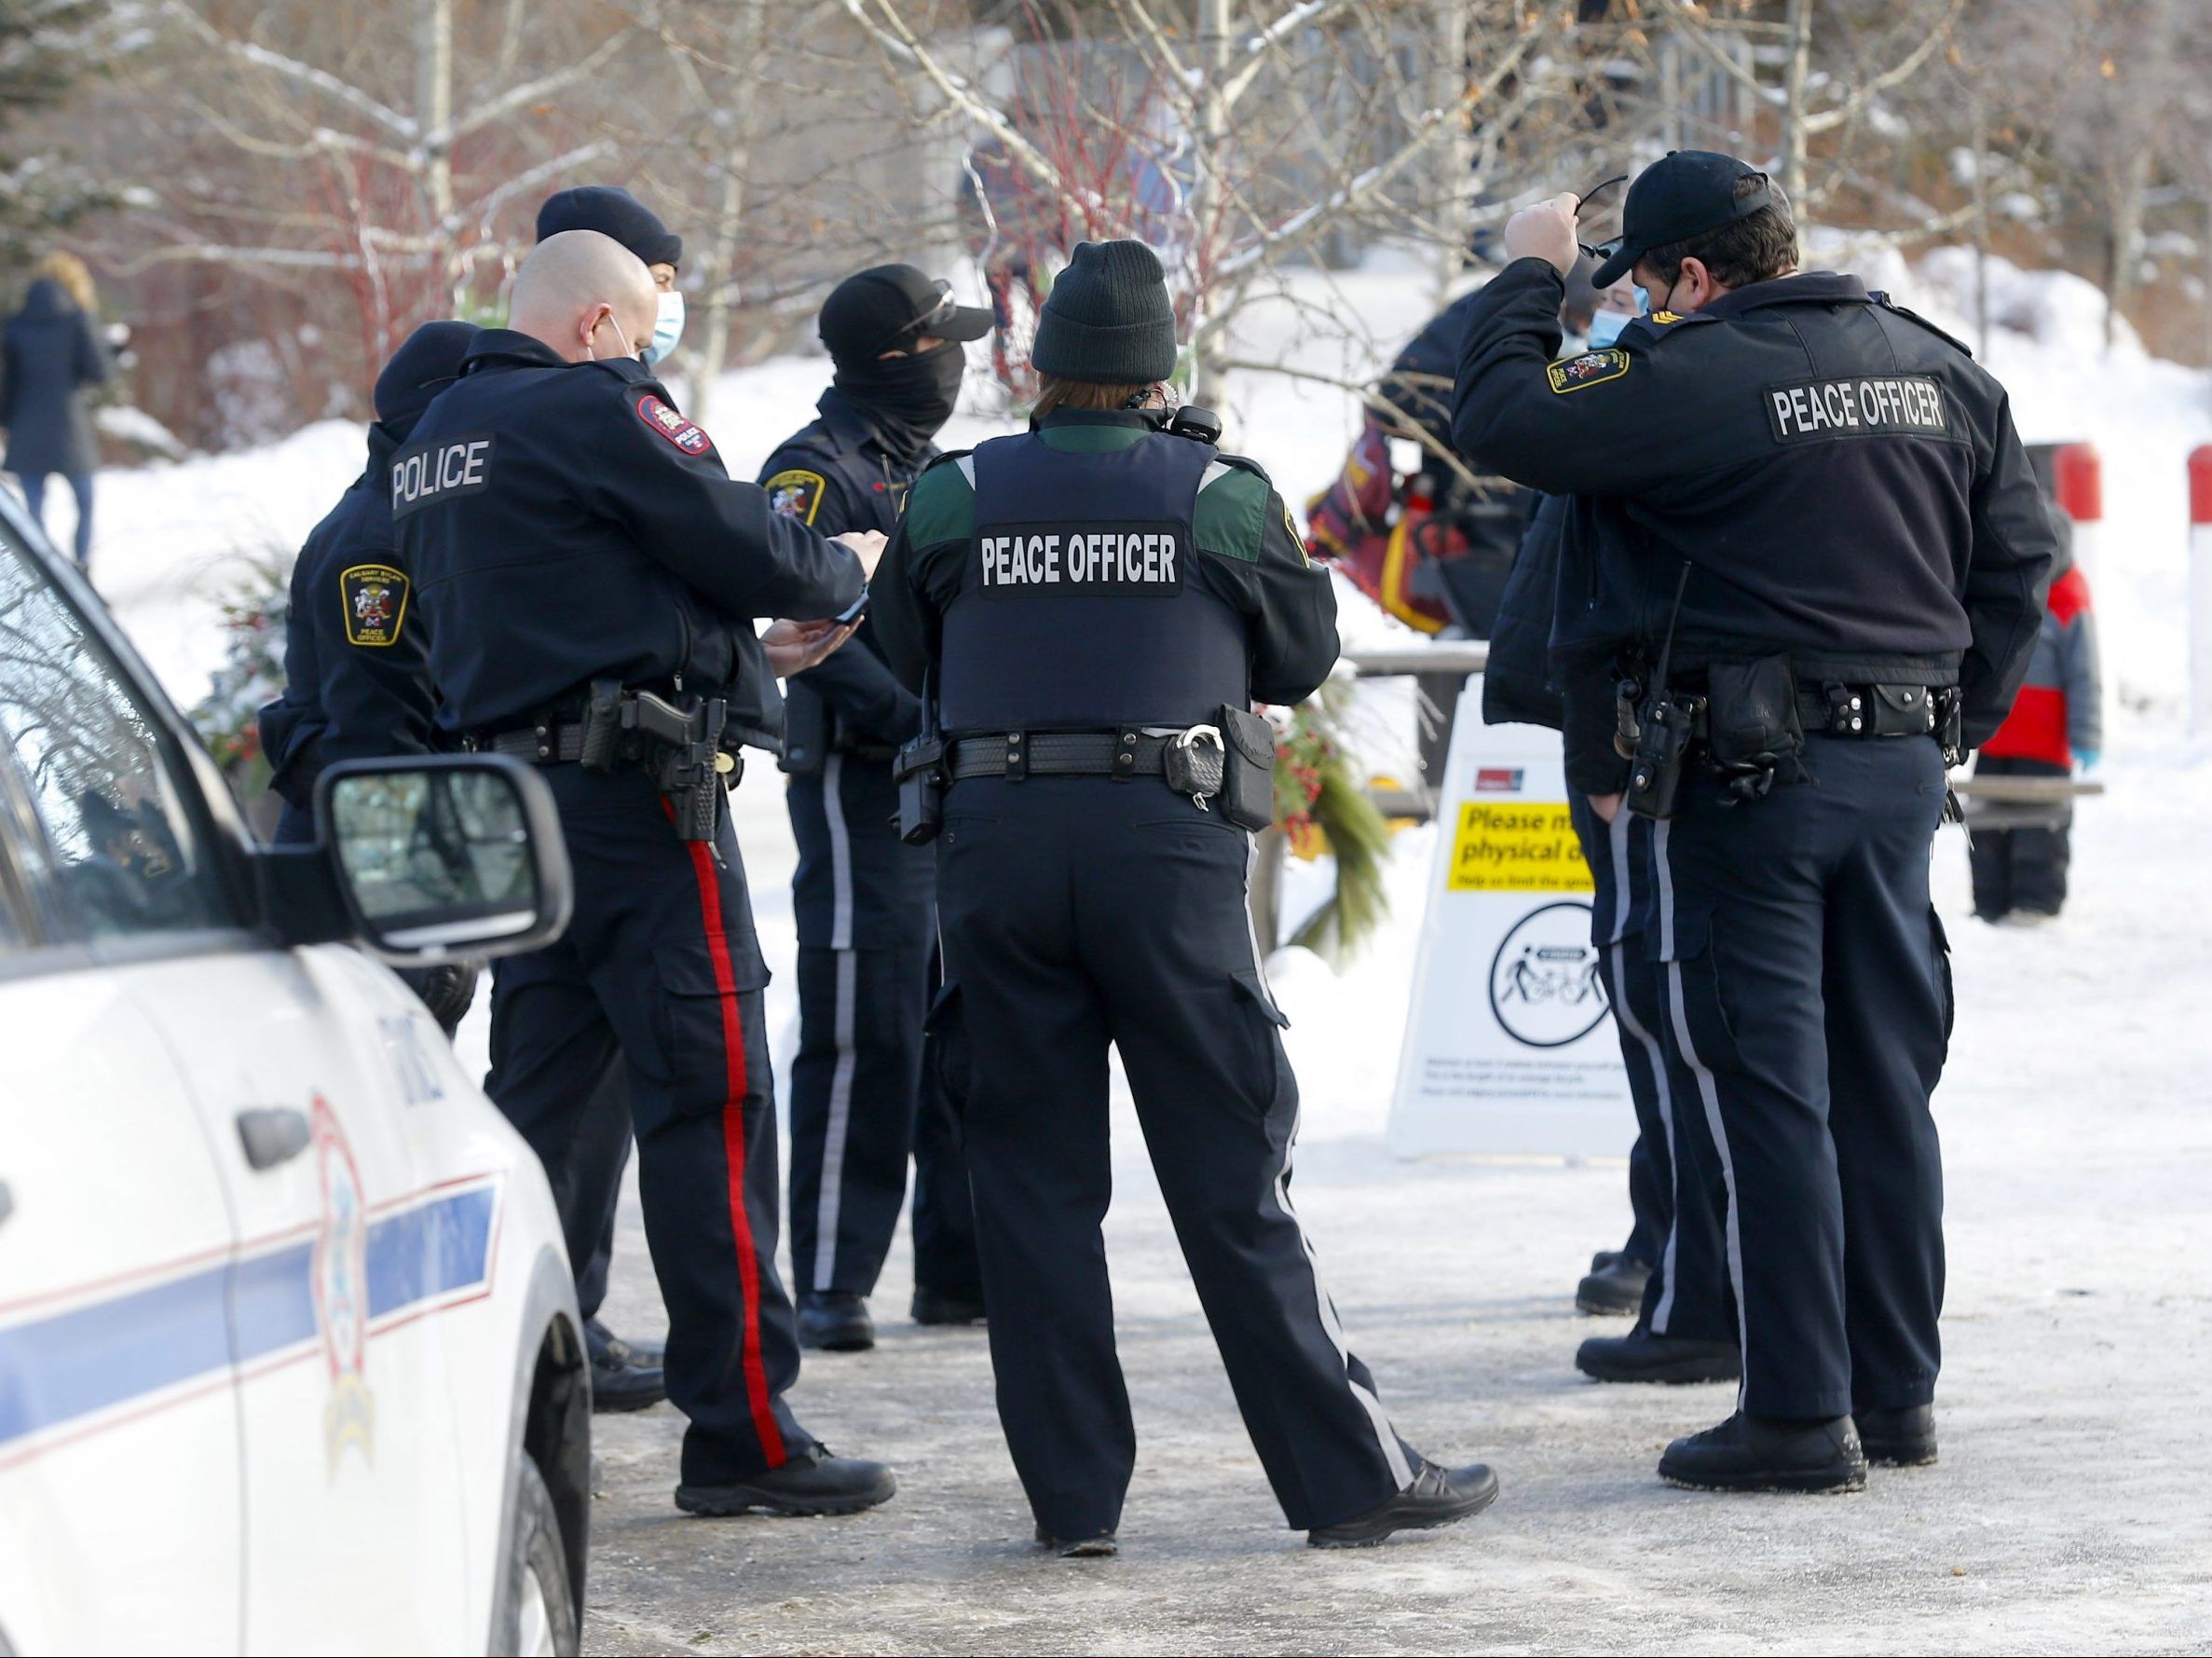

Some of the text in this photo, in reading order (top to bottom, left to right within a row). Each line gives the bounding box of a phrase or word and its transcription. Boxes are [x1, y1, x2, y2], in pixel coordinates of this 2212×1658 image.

[1772, 380, 1944, 435] PEACE OFFICER
[675, 427, 701, 445] POLICE
[392, 441, 490, 510] POLICE
[981, 533, 1176, 586] PEACE OFFICER
[1468, 806, 1545, 830] Please
[1461, 837, 1562, 868] physical
